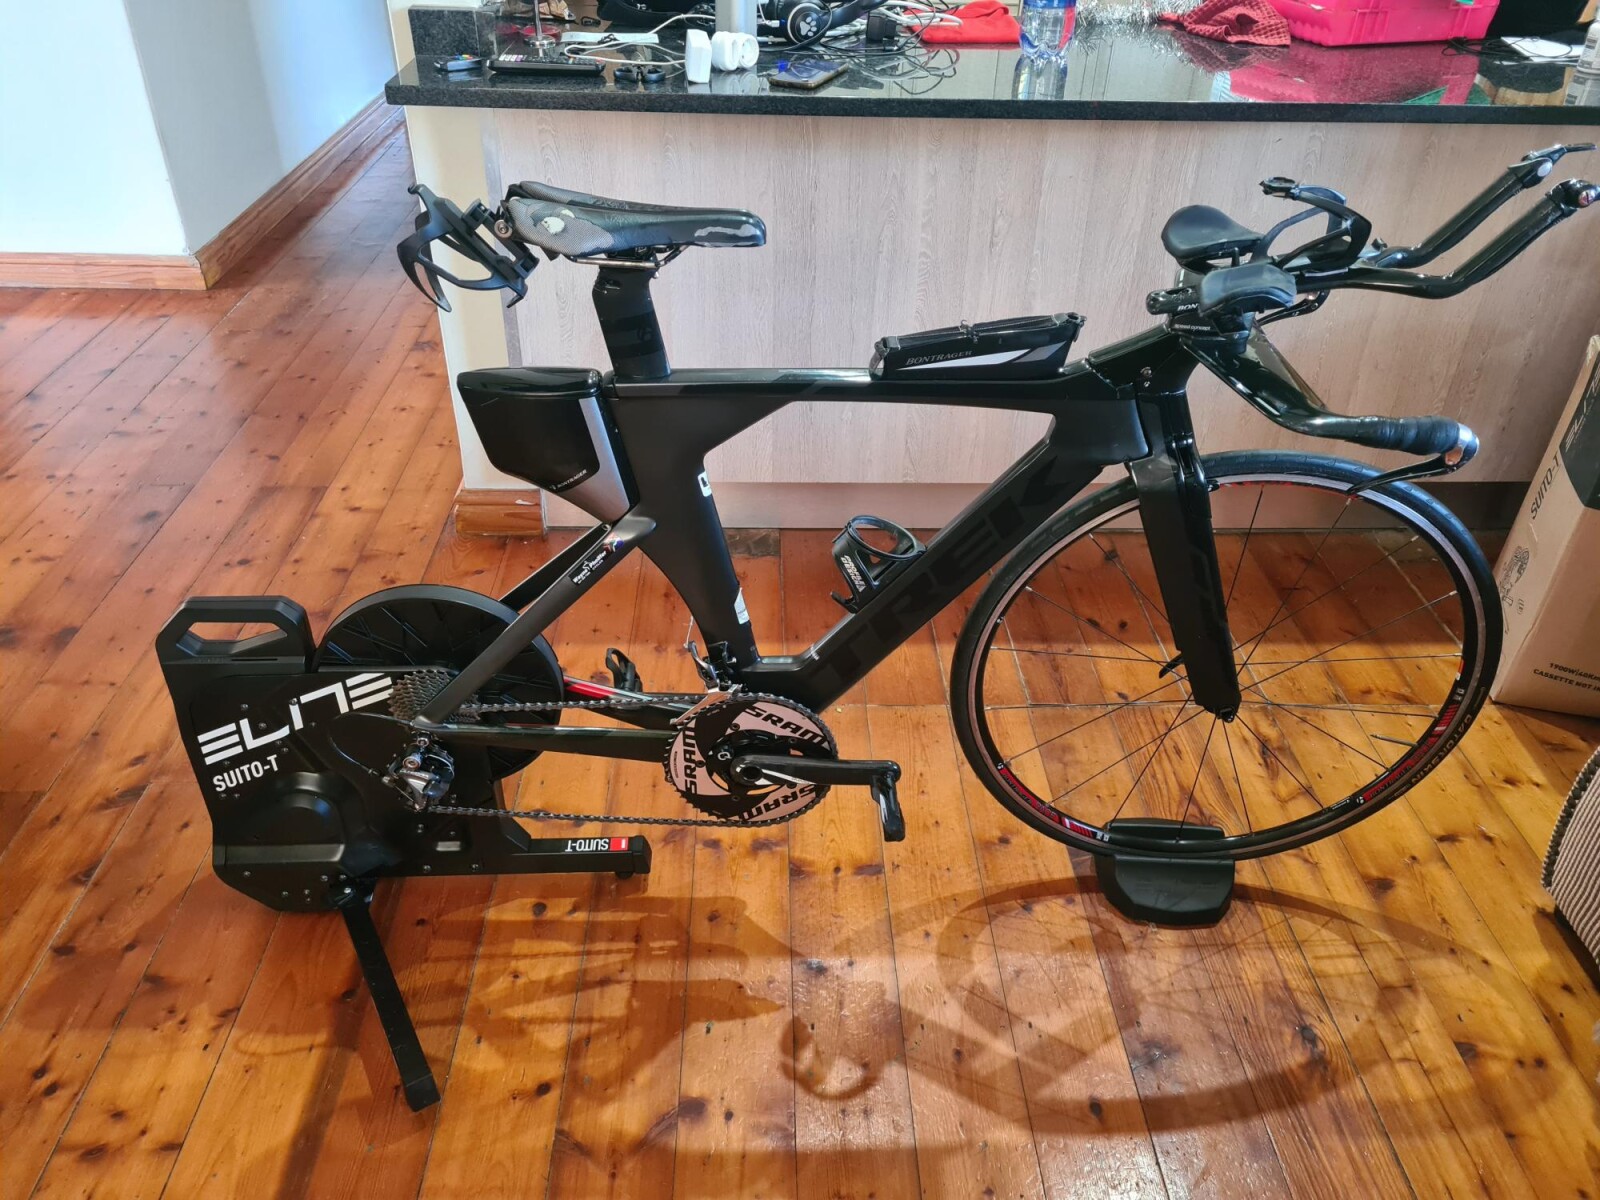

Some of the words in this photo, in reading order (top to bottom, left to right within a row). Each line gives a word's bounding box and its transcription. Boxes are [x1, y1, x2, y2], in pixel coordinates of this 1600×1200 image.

[905, 350, 973, 366] BONTRAGER
[1530, 451, 1560, 520] SUITO-T
[808, 455, 1074, 682] TREK
[1533, 668, 1575, 685] CASSETTE
[1575, 680, 1592, 689] NOT
[197, 672, 393, 766] ELITE
[744, 705, 827, 747] SRAM
[212, 754, 279, 792] SUITO-T
[682, 725, 698, 795] SRAM
[739, 784, 817, 822] SRAM
[565, 838, 610, 852] SUITO-T
